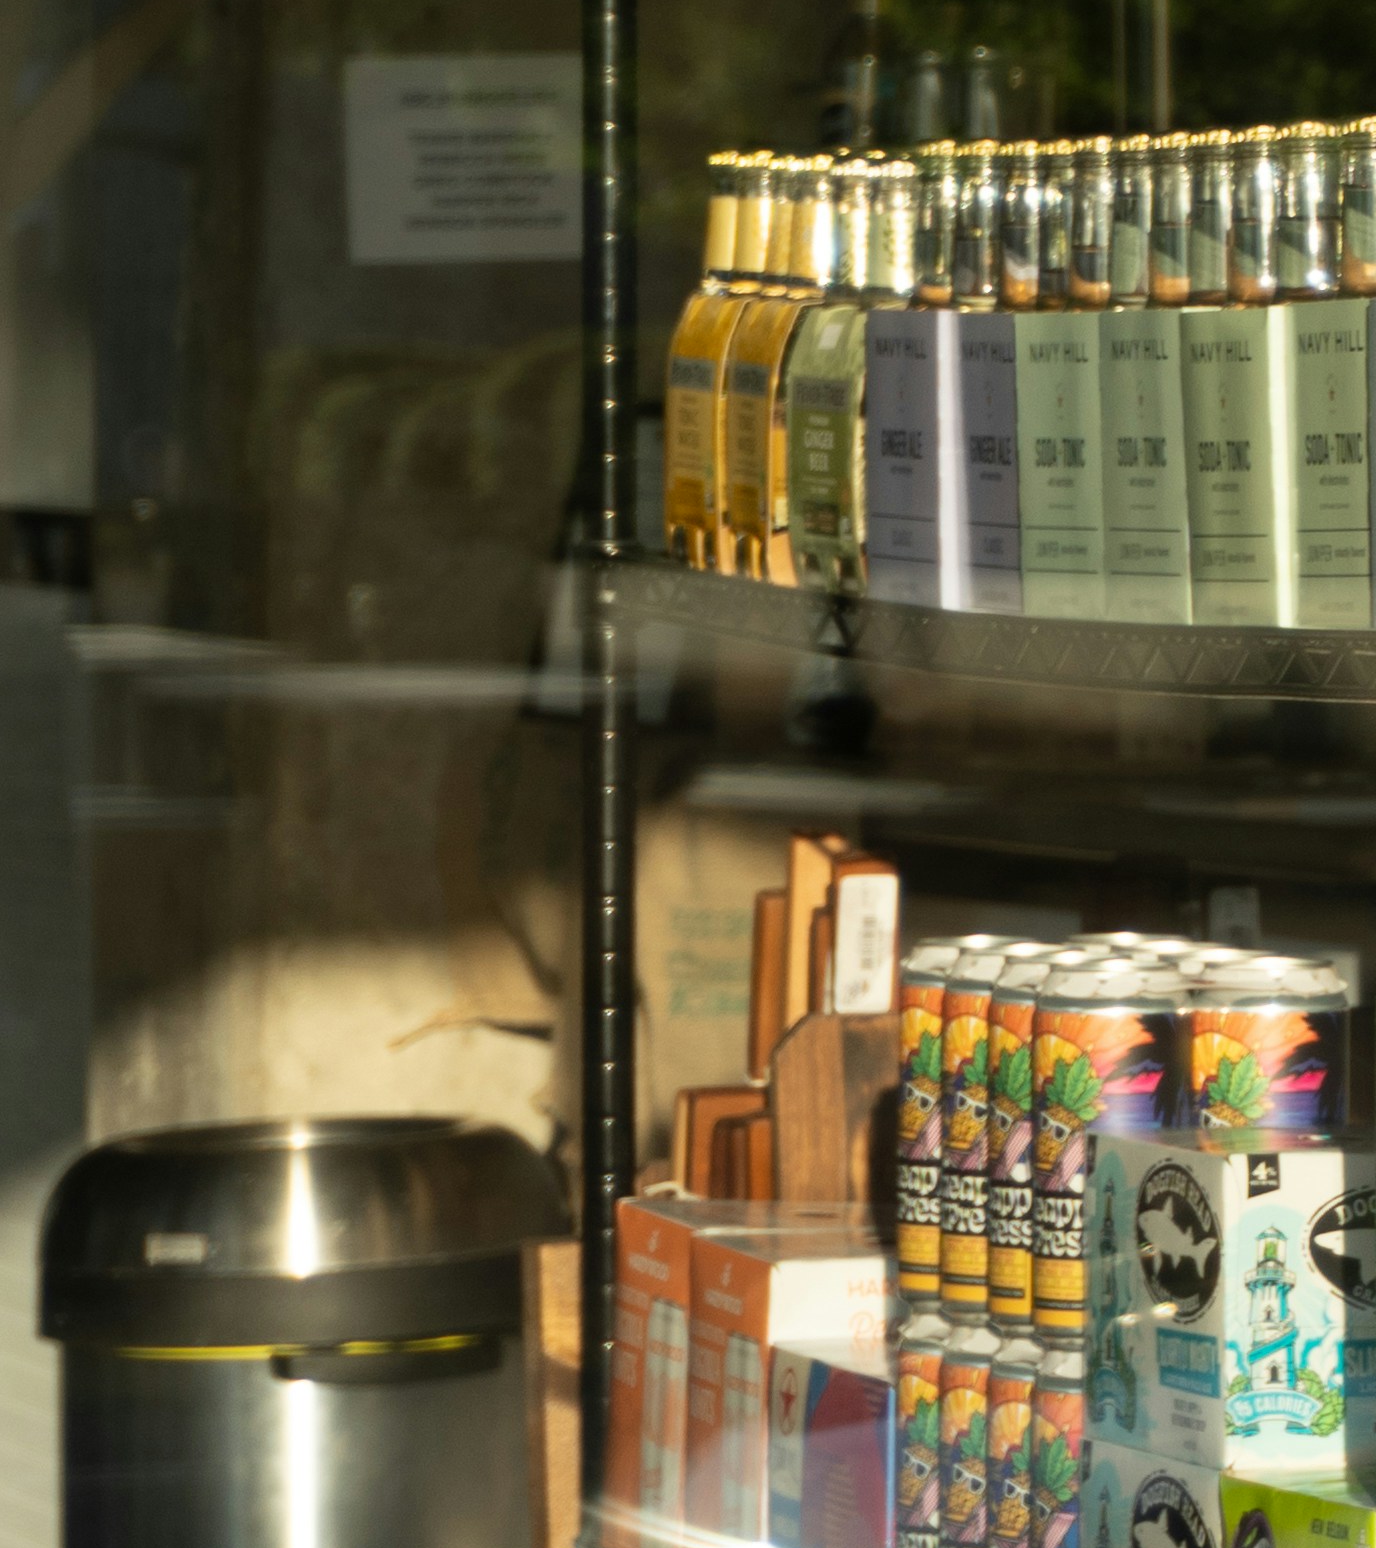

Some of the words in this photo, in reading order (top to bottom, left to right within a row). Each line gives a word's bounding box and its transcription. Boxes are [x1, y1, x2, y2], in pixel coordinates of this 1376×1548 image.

[876, 338, 901, 360] NAVY
[903, 338, 927, 360] HILL
[963, 341, 988, 364] NAVY
[990, 341, 1014, 364] HILL
[1030, 342, 1060, 364] NAVY
[1063, 342, 1088, 363] HILL
[1111, 339, 1139, 363] NAVY
[1143, 338, 1168, 360] HILL
[1190, 341, 1221, 364] NAVY
[1224, 340, 1252, 362] HILL
[1298, 331, 1330, 354] NAVY
[1334, 329, 1364, 352] HILL
[881, 429, 907, 459] GINGER
[908, 430, 923, 460] ALE
[969, 434, 996, 464] GINGER
[998, 436, 1012, 466] ALE
[1036, 437, 1057, 468] SODA
[1062, 437, 1085, 468] TONIC
[1117, 437, 1138, 468] SODA
[1143, 437, 1167, 468] TONIC
[1199, 440, 1221, 472] SODA
[1226, 440, 1251, 472] TONIC
[1305, 433, 1329, 466] SODA
[1334, 432, 1363, 464] TONIC
[1257, 1395, 1315, 1416] CALORIES
